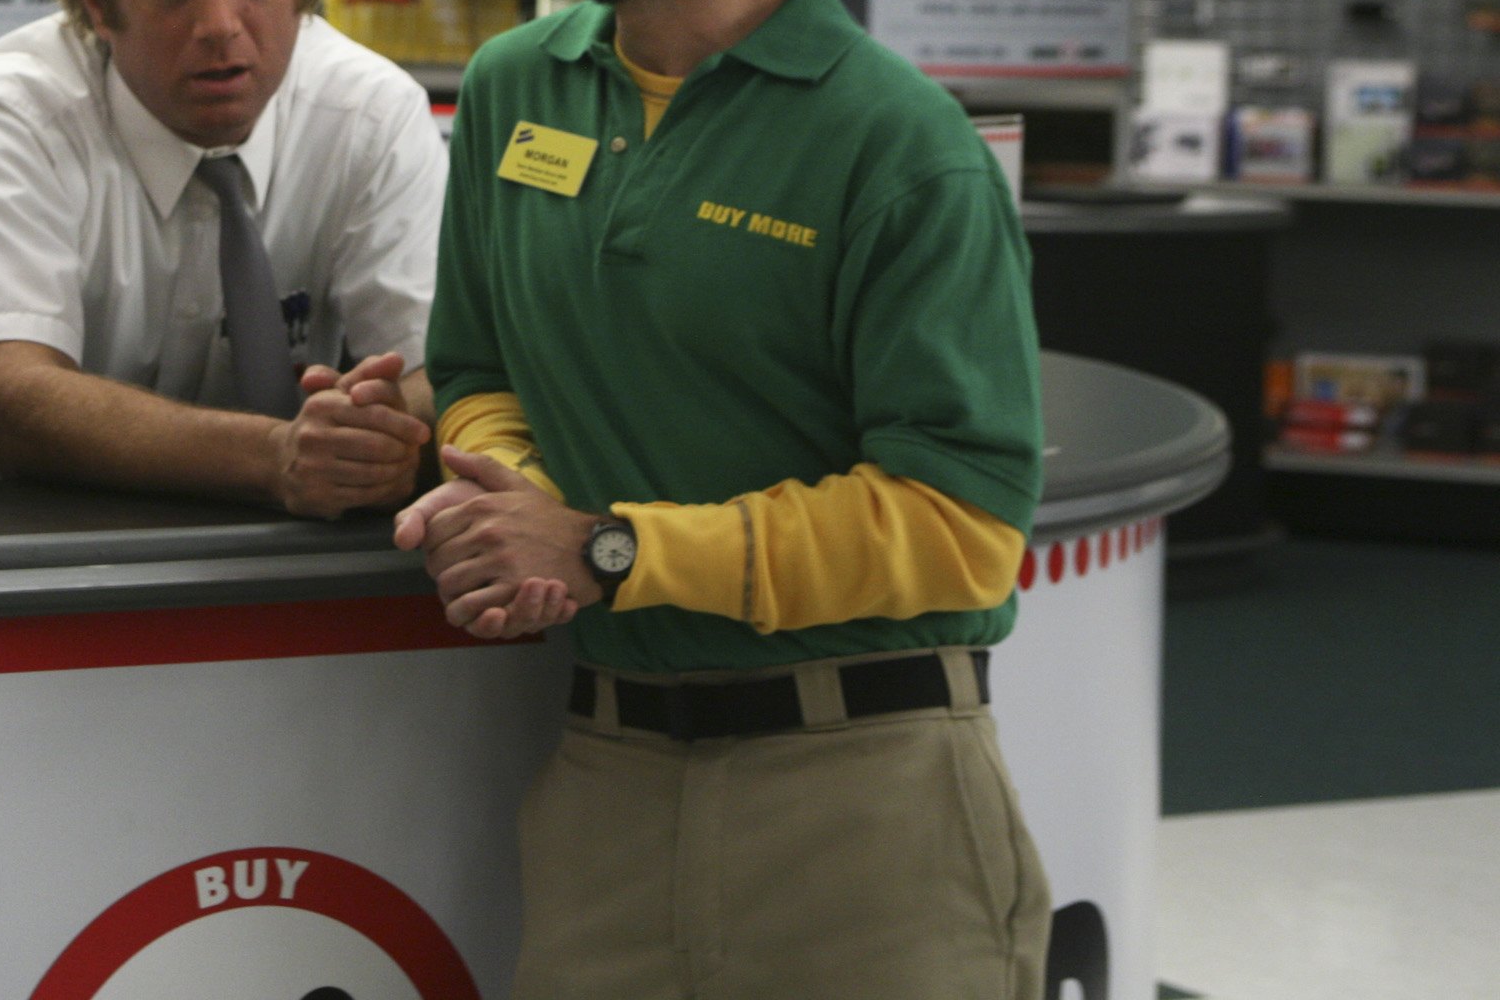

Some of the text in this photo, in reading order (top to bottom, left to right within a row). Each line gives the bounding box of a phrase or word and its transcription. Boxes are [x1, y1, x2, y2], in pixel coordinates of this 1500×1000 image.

[525, 148, 569, 169] MORGAN
[696, 200, 818, 248] BUY MORE
[194, 858, 311, 910] BUY
